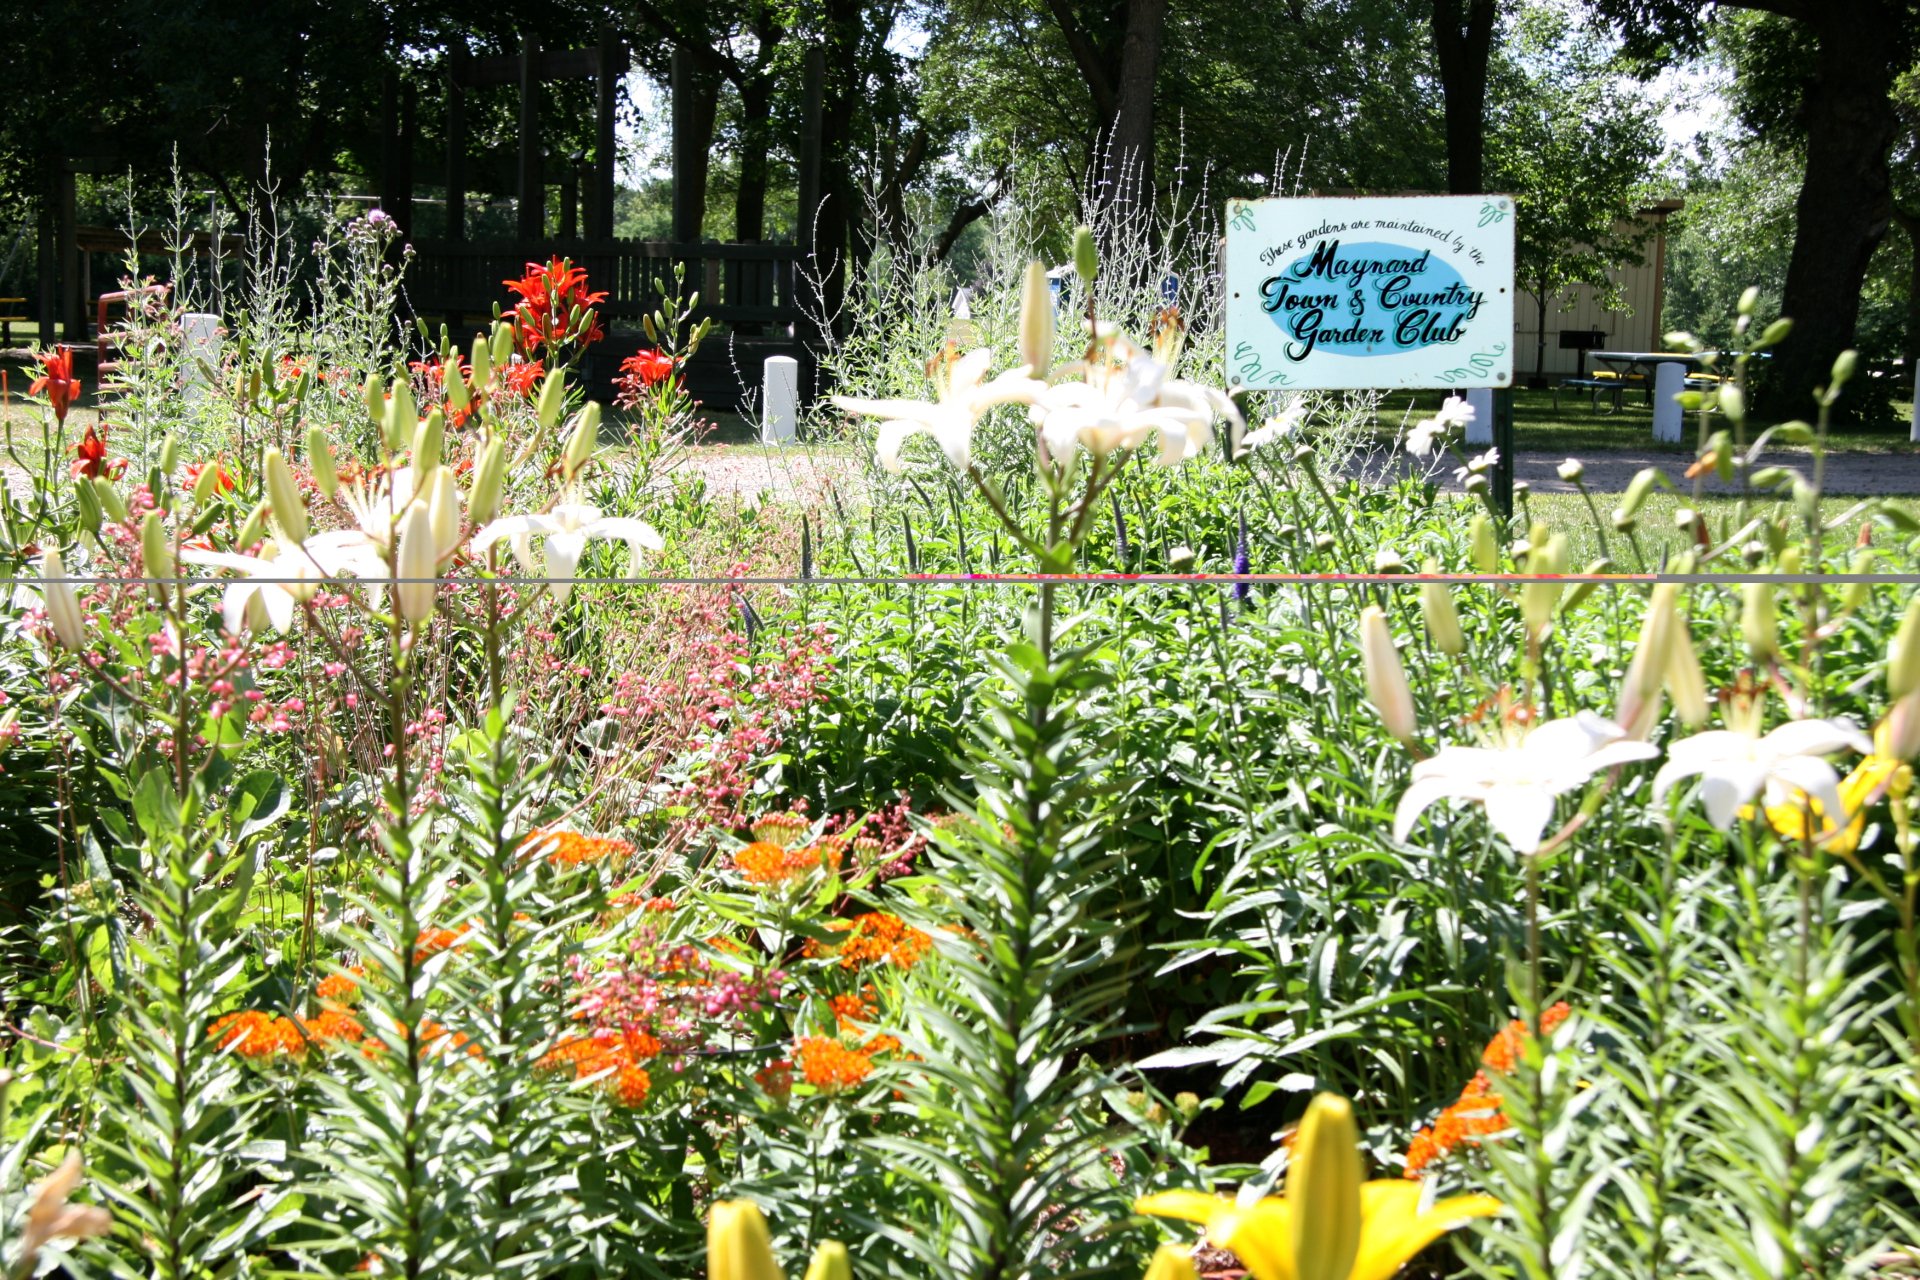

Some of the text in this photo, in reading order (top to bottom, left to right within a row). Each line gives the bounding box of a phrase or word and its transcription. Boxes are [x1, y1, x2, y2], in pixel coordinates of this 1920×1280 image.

[1259, 218, 1486, 267] These gardens are maintained by the
[1293, 239, 1430, 288] Maynard
[1260, 275, 1488, 320] Town & Country
[1283, 309, 1467, 362] Garden Club
